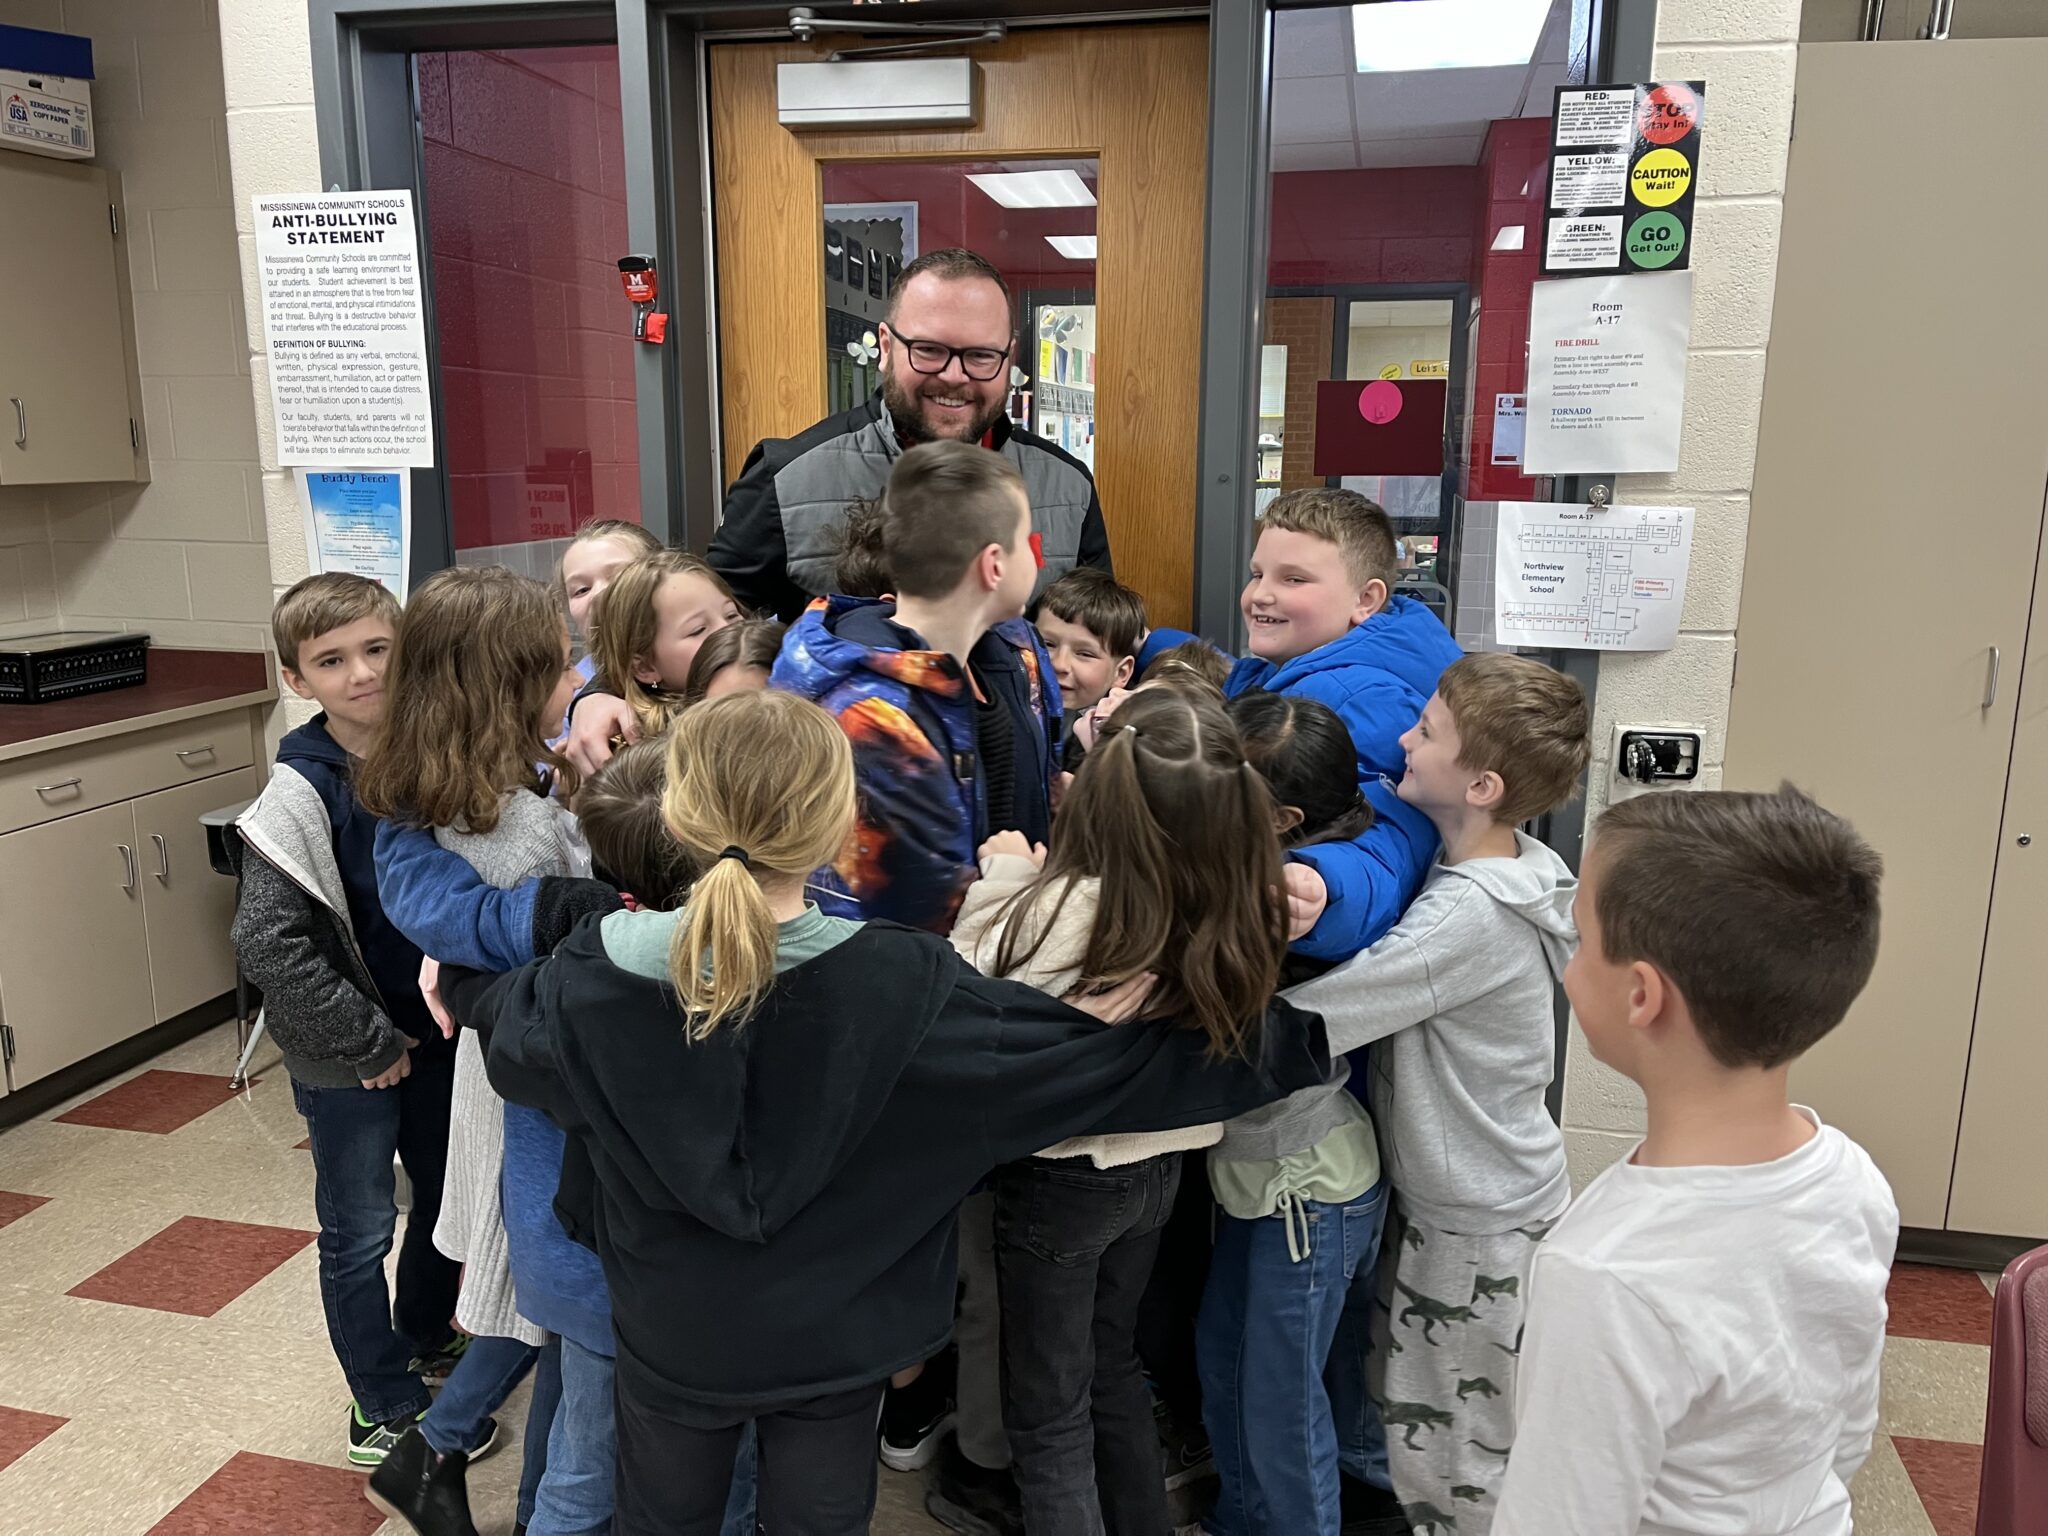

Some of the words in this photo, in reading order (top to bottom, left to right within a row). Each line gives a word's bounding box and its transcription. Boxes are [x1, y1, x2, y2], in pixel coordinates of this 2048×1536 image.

[30, 101, 71, 116] XEROGRAPHIC
[10, 107, 28, 121] USA
[50, 115, 69, 124] PAPER
[1568, 157, 1615, 165] YELLOW:
[1633, 168, 1689, 180] CAUTION
[1646, 181, 1675, 190] Wait!
[260, 202, 316, 211] MISSISSINEWA
[318, 201, 365, 210] COMMUNITY
[368, 200, 405, 208] SCHOOLS
[273, 213, 397, 228] ANTI-BULLYING
[1566, 224, 1606, 232] GREEN:
[288, 230, 384, 244] STATEMENT
[1640, 226, 1670, 241] GO
[1630, 244, 1651, 253] Get
[1654, 243, 1679, 252] Out!
[629, 274, 643, 285] M
[1592, 303, 1623, 312] Room
[1595, 315, 1621, 325] A-17
[1575, 338, 1599, 346] DRILL
[322, 474, 355, 484] Buddy
[361, 474, 389, 483] Bench
[1524, 562, 1564, 571] Northview
[1522, 574, 1565, 584] Elementary
[1530, 585, 1554, 593] School
